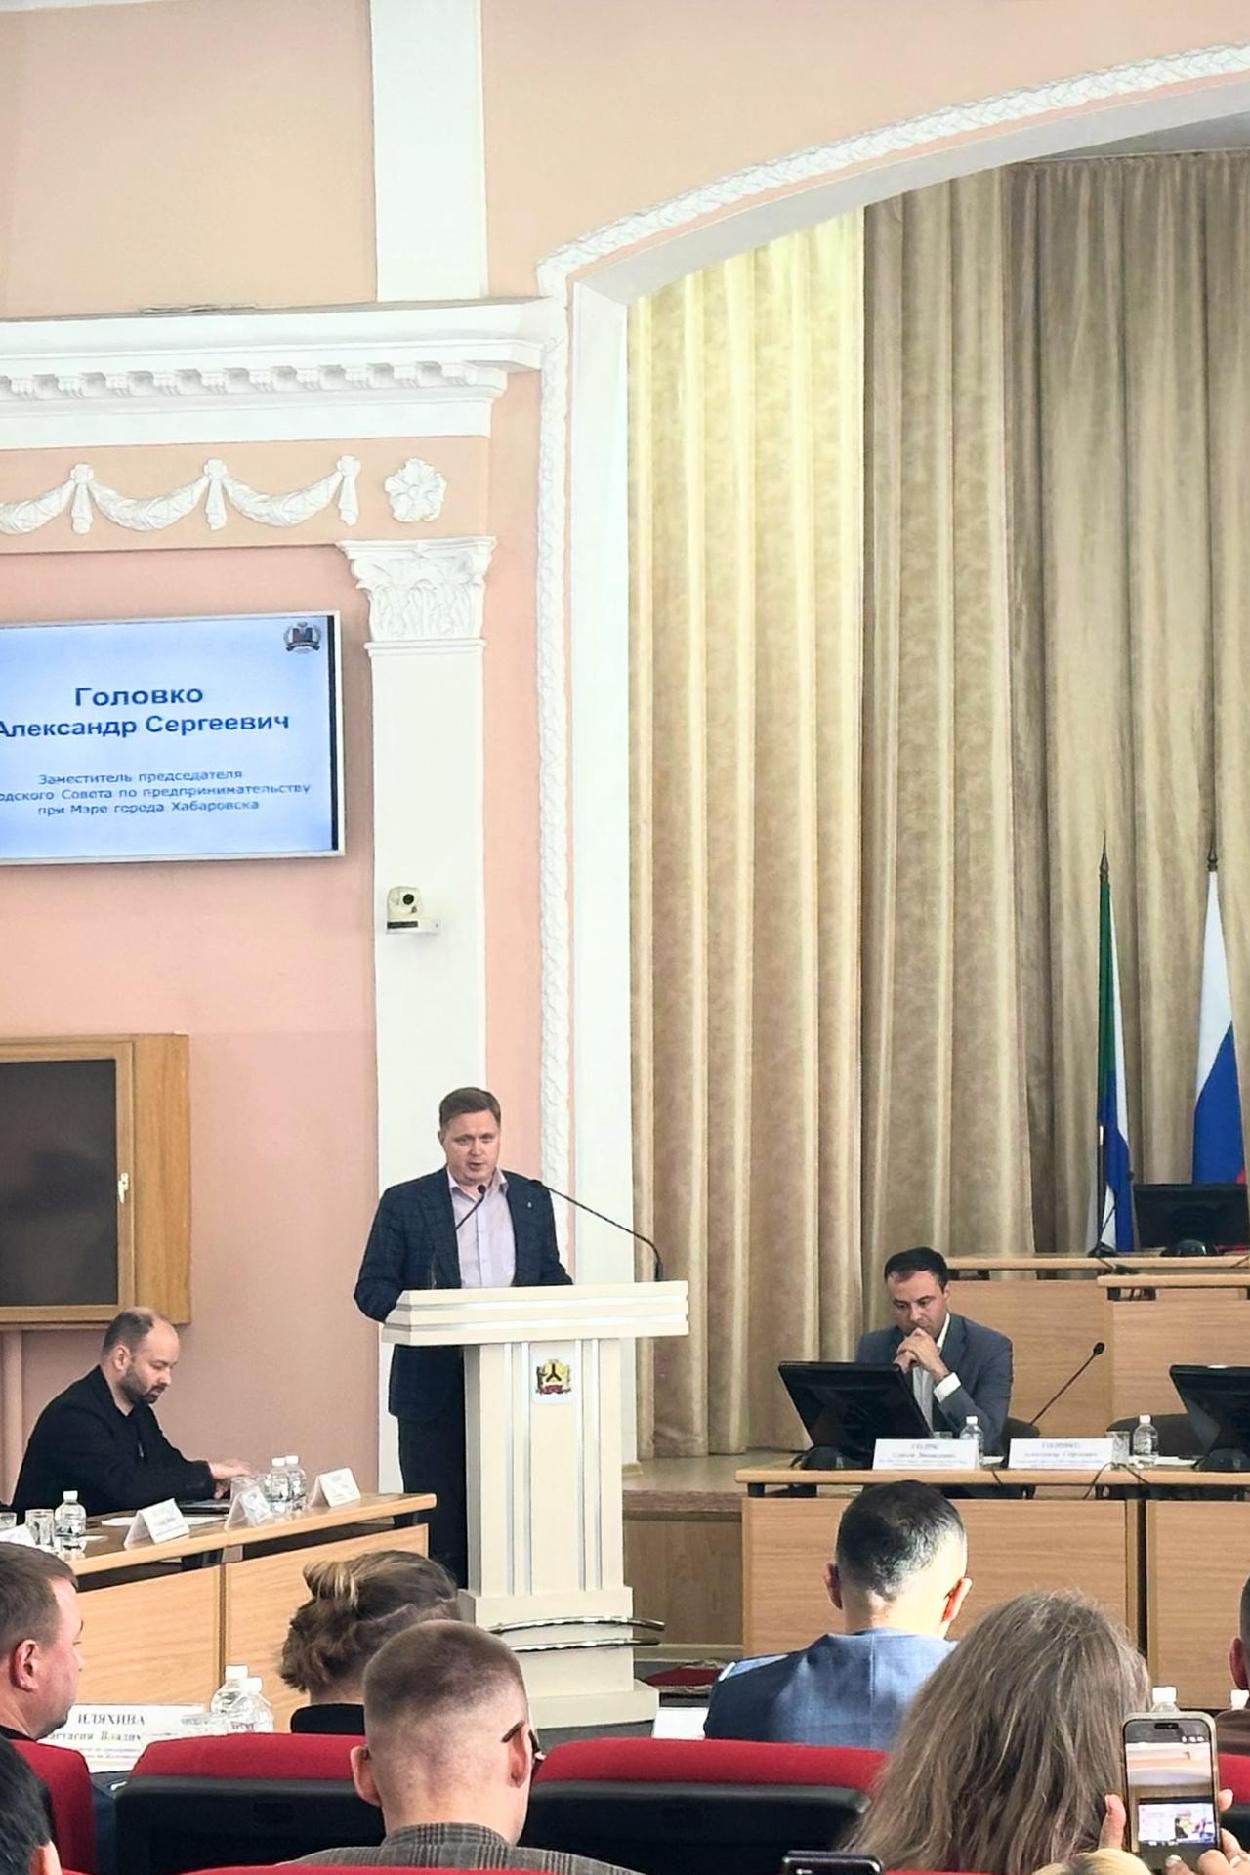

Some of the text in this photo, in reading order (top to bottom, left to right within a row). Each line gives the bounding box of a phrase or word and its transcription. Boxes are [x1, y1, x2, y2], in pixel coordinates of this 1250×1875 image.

[75, 687, 204, 706] Головко
[0, 715, 290, 738] Александр Сергеевич
[38, 769, 243, 786] Заместитель председателя
[61, 787, 112, 800] Совета
[118, 788, 138, 799] по
[143, 783, 312, 799] предпринимательству
[38, 800, 259, 816] при Мэре города Хабаровска
